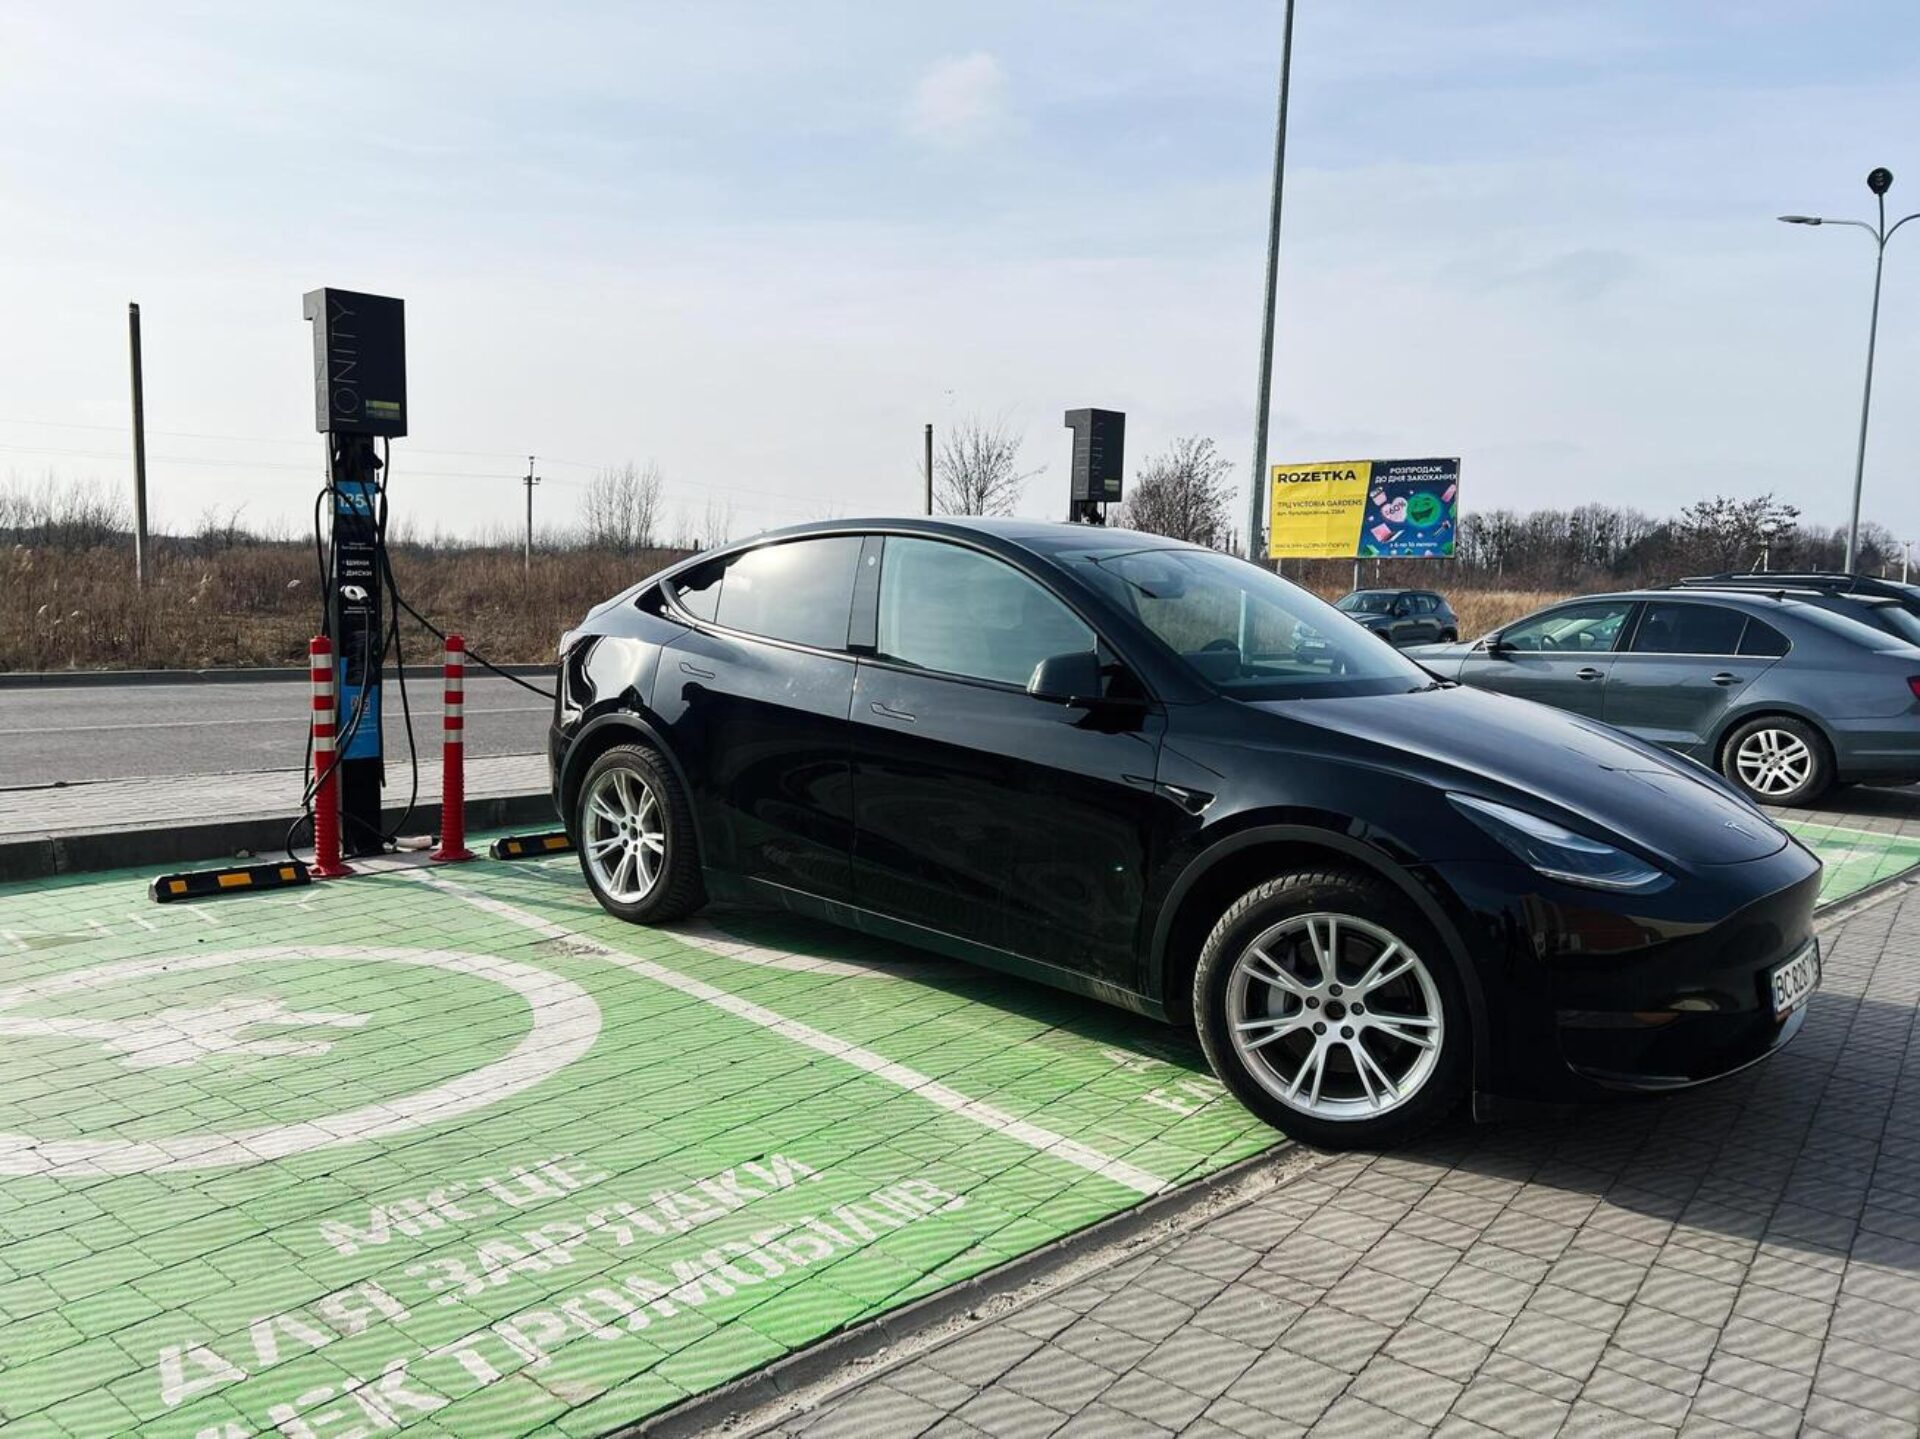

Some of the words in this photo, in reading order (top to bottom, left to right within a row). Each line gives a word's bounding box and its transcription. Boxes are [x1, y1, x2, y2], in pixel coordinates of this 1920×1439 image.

[331, 299, 360, 423] IONITY
[1278, 470, 1357, 483] ROZETKA
[1389, 466, 1442, 474] РОЗПРОДАЖ
[1407, 473, 1457, 481] ЗАКОХАНИХ
[346, 569, 373, 577] ДИСКИ
[319, 1154, 611, 1256] МІСЦЕ
[159, 1279, 411, 1407] ДЛЯ
[404, 1153, 824, 1305] ЗАРЯДКИ
